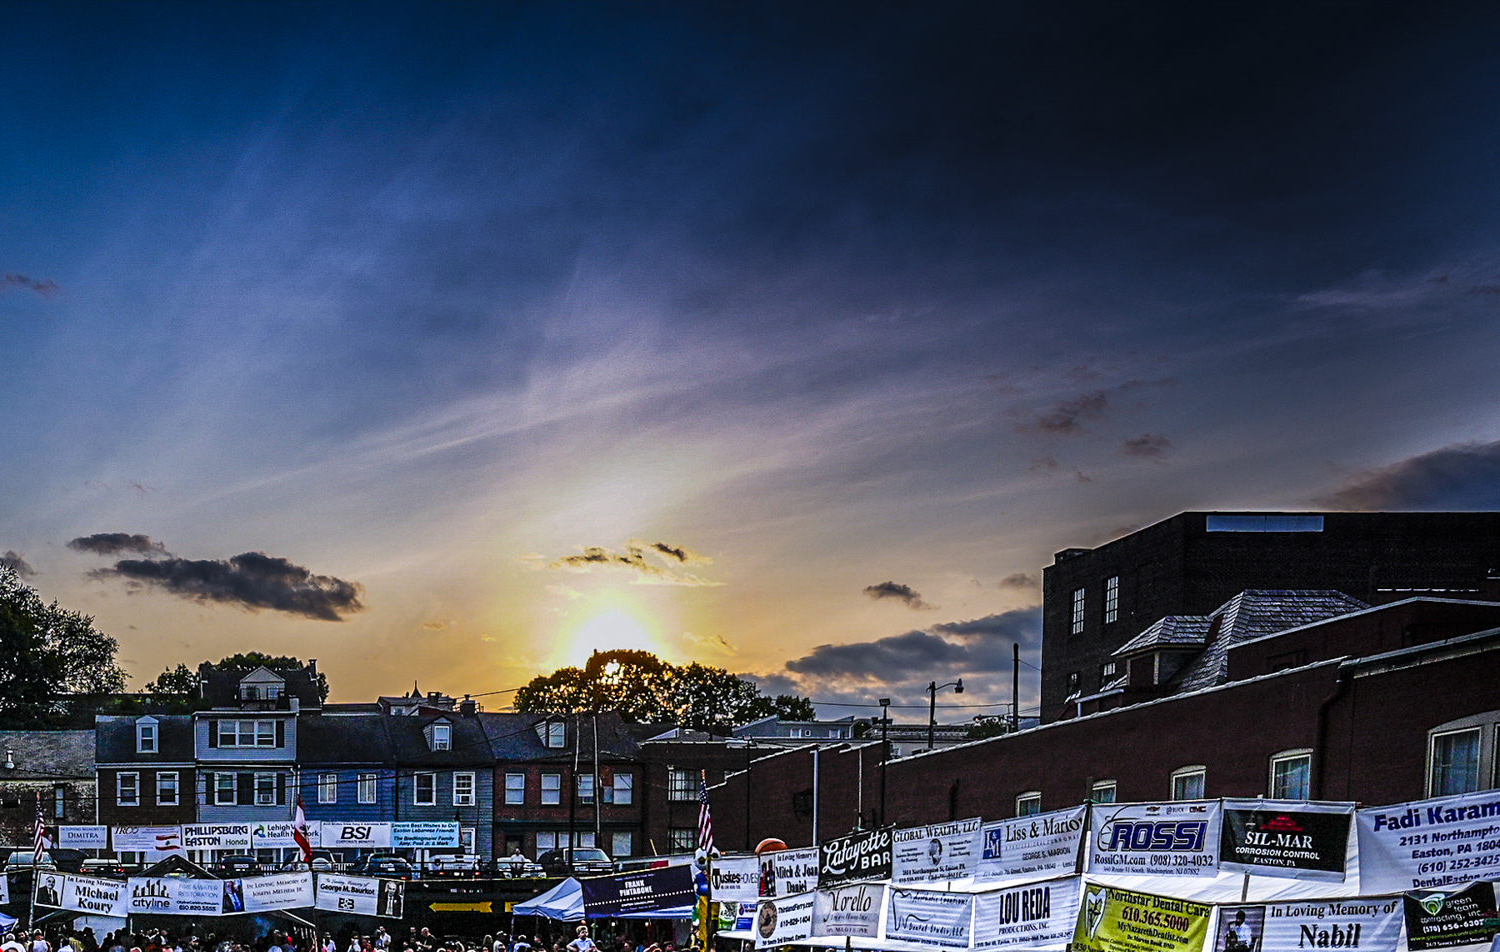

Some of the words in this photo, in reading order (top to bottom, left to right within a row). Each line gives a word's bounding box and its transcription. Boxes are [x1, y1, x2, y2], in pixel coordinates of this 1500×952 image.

[1374, 808, 1421, 832] Fadi
[1427, 801, 1500, 825] Karam
[184, 825, 248, 836] PHILLIPSBURG
[267, 824, 291, 832] Lehigh
[341, 826, 372, 839] BSI
[893, 829, 924, 843] GLOBAL
[925, 824, 961, 839] WEALTH,
[963, 821, 979, 833] LLC
[1005, 823, 1027, 842] Liss
[1029, 821, 1040, 839] &
[1108, 820, 1209, 852] ROSSI
[185, 837, 221, 847] EASTON
[225, 838, 248, 846] Honda
[1244, 830, 1313, 849] SIL-MAR
[1399, 834, 1428, 846] 2131
[821, 831, 891, 875] Lafayette
[861, 850, 891, 870] BAR
[1094, 853, 1146, 866] RossiGM.com
[1150, 853, 1171, 867] (908)
[1172, 854, 1213, 867] 320-4032
[1235, 846, 1281, 857] CORROSION
[1282, 850, 1320, 860] CONTROL
[1412, 848, 1454, 860] Easton,
[1457, 844, 1472, 854] PA
[1253, 857, 1286, 866] EASTON,
[1418, 861, 1446, 875] (610)
[1449, 854, 1500, 870] 252-3425
[776, 864, 793, 879] Mitch
[794, 864, 801, 875] &
[802, 863, 818, 877] Joan
[75, 877, 96, 886] Loving
[96, 880, 120, 890] Memory
[320, 883, 342, 892] George
[351, 886, 375, 895] Baurkot
[619, 886, 653, 897] PINTABONE
[624, 879, 645, 889] FRANK
[786, 880, 807, 894] Daniel
[75, 885, 119, 901] Michael
[77, 897, 114, 914] Koury
[132, 898, 170, 910] cityline
[999, 891, 1019, 924] LOU
[1021, 886, 1050, 921] REDA
[1106, 888, 1152, 908] Northstar
[1152, 895, 1184, 913] Dental
[1185, 899, 1210, 918] Care
[1271, 906, 1282, 917] In
[1286, 905, 1325, 919] Loving
[1328, 903, 1380, 918] Memory
[1383, 901, 1398, 914] of
[1445, 897, 1472, 908] green
[1453, 903, 1479, 912] team
[1122, 906, 1190, 932] 610.365.5000
[1420, 912, 1466, 924] contracting,
[1117, 920, 1190, 944] MyNazarethDentist.com
[1298, 923, 1361, 949] Nabil
